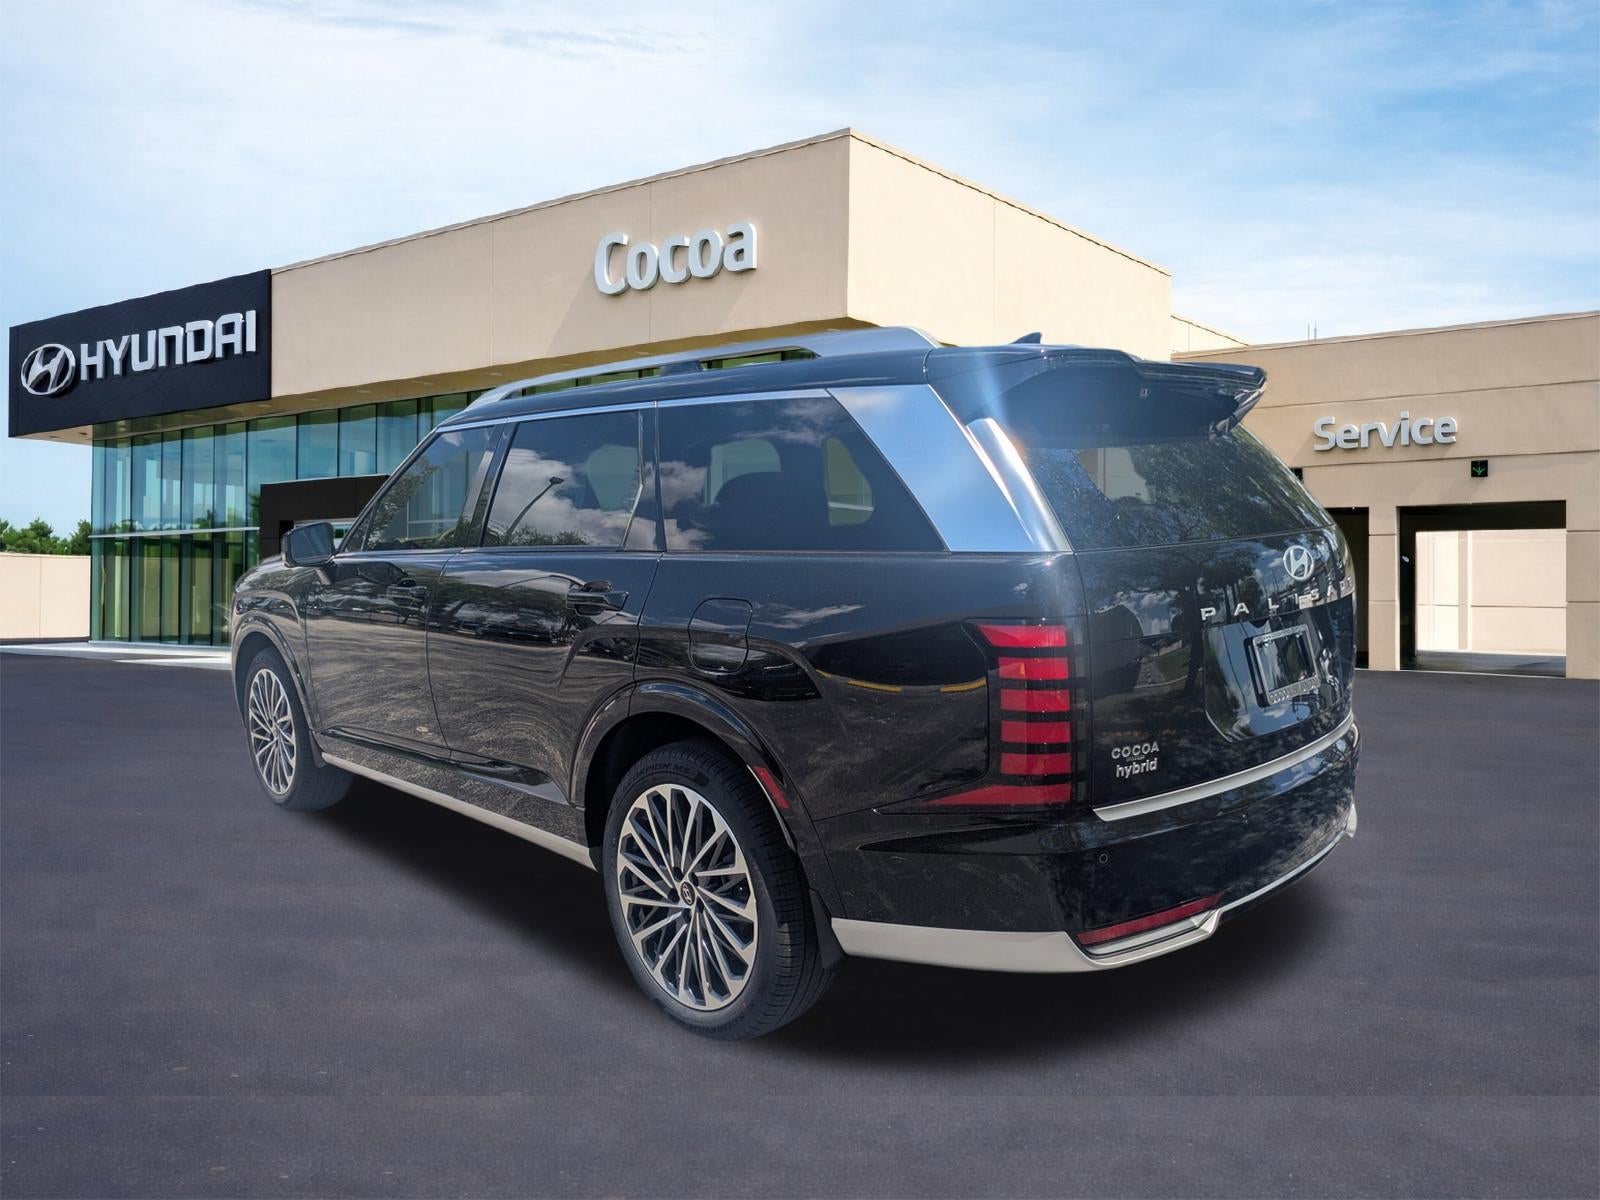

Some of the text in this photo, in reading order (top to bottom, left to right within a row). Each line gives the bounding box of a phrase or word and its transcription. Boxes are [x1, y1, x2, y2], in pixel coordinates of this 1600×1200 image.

[594, 222, 757, 295] Cocoa
[80, 310, 256, 381] HYUNDAI
[1313, 411, 1458, 451] Service
[1111, 741, 1160, 759] COCOA
[1115, 757, 1158, 778] hybrid
